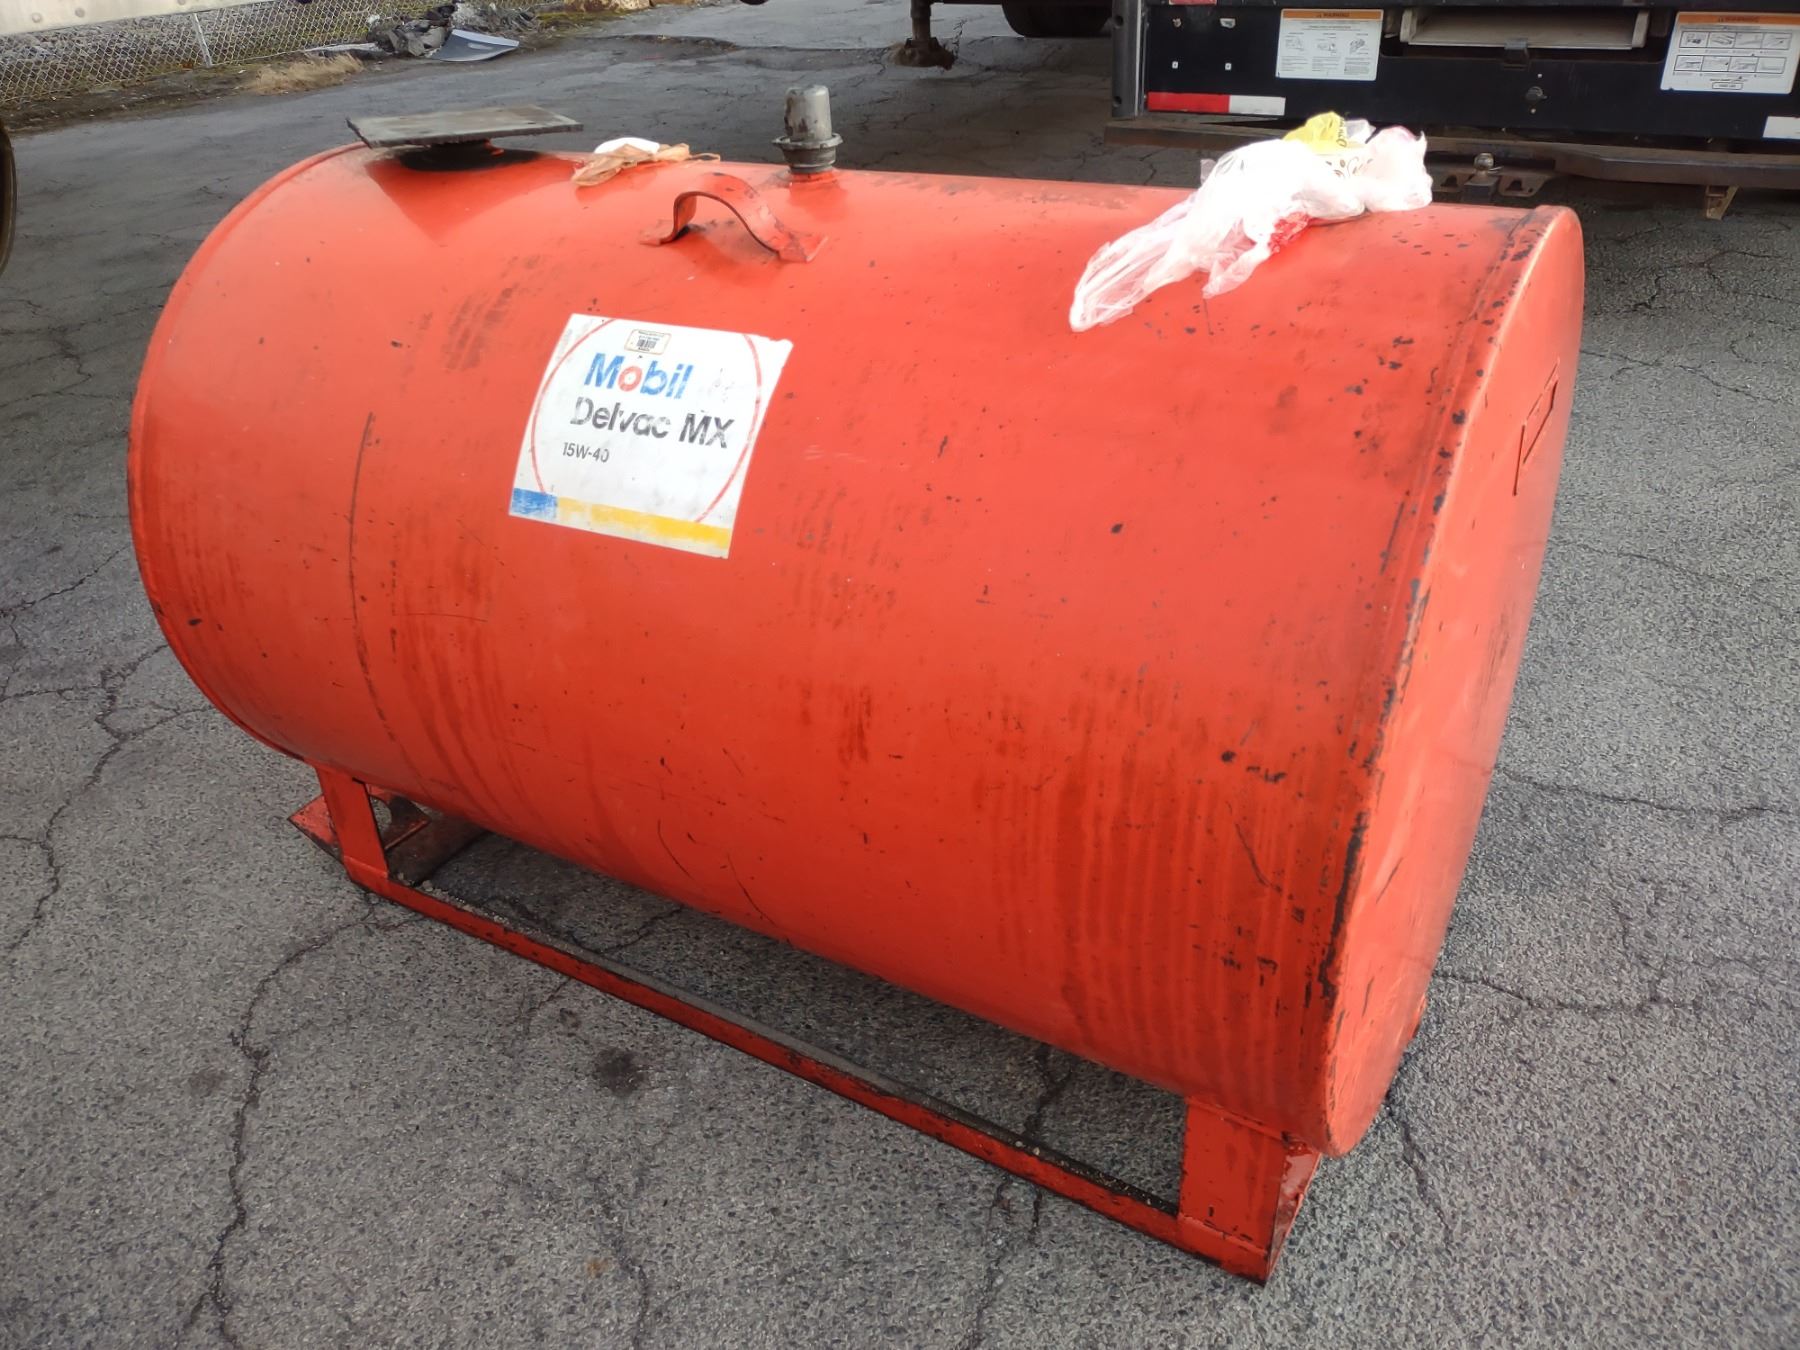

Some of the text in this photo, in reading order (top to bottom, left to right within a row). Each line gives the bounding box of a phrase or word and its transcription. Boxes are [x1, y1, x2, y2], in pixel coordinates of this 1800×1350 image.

[584, 352, 694, 400] Mobil
[570, 396, 736, 449] Delvac MX
[562, 441, 610, 463] 15W-40
